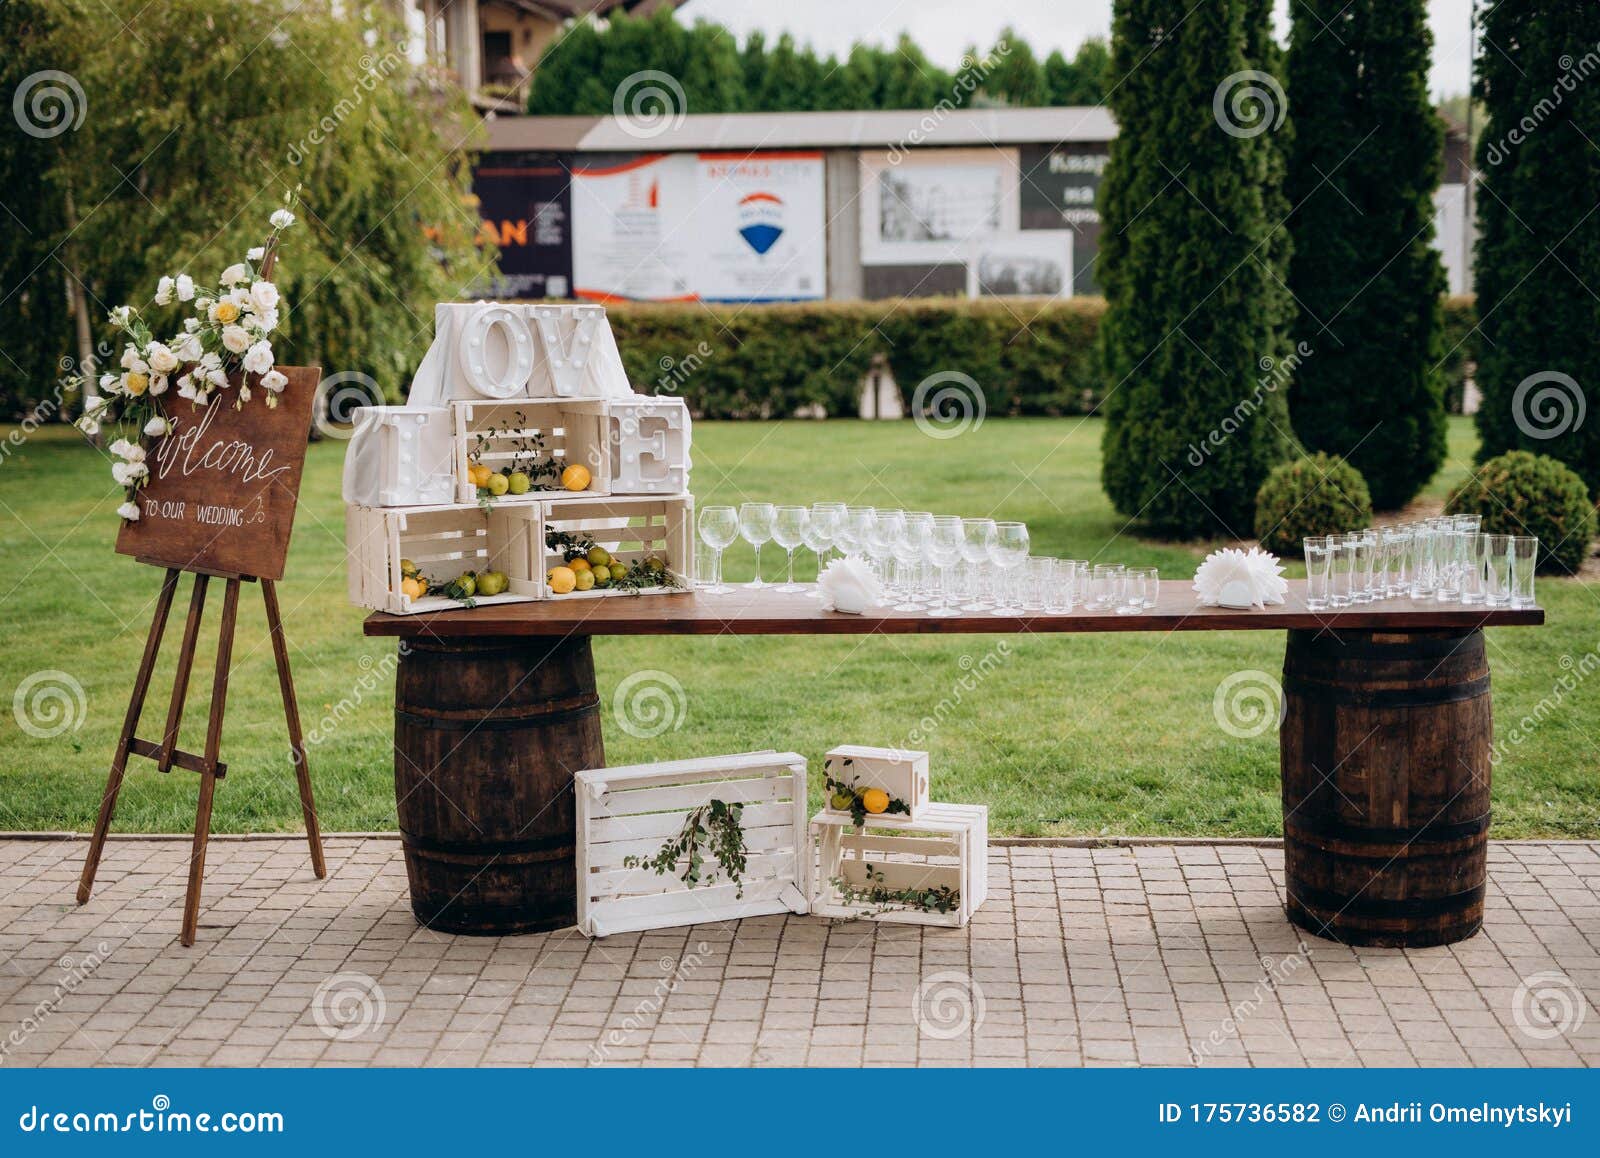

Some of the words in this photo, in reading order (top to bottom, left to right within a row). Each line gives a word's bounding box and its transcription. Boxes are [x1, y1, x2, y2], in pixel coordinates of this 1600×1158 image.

[145, 499, 158, 517] TO
[162, 501, 186, 520] OUR
[196, 504, 244, 527] WEDDING
